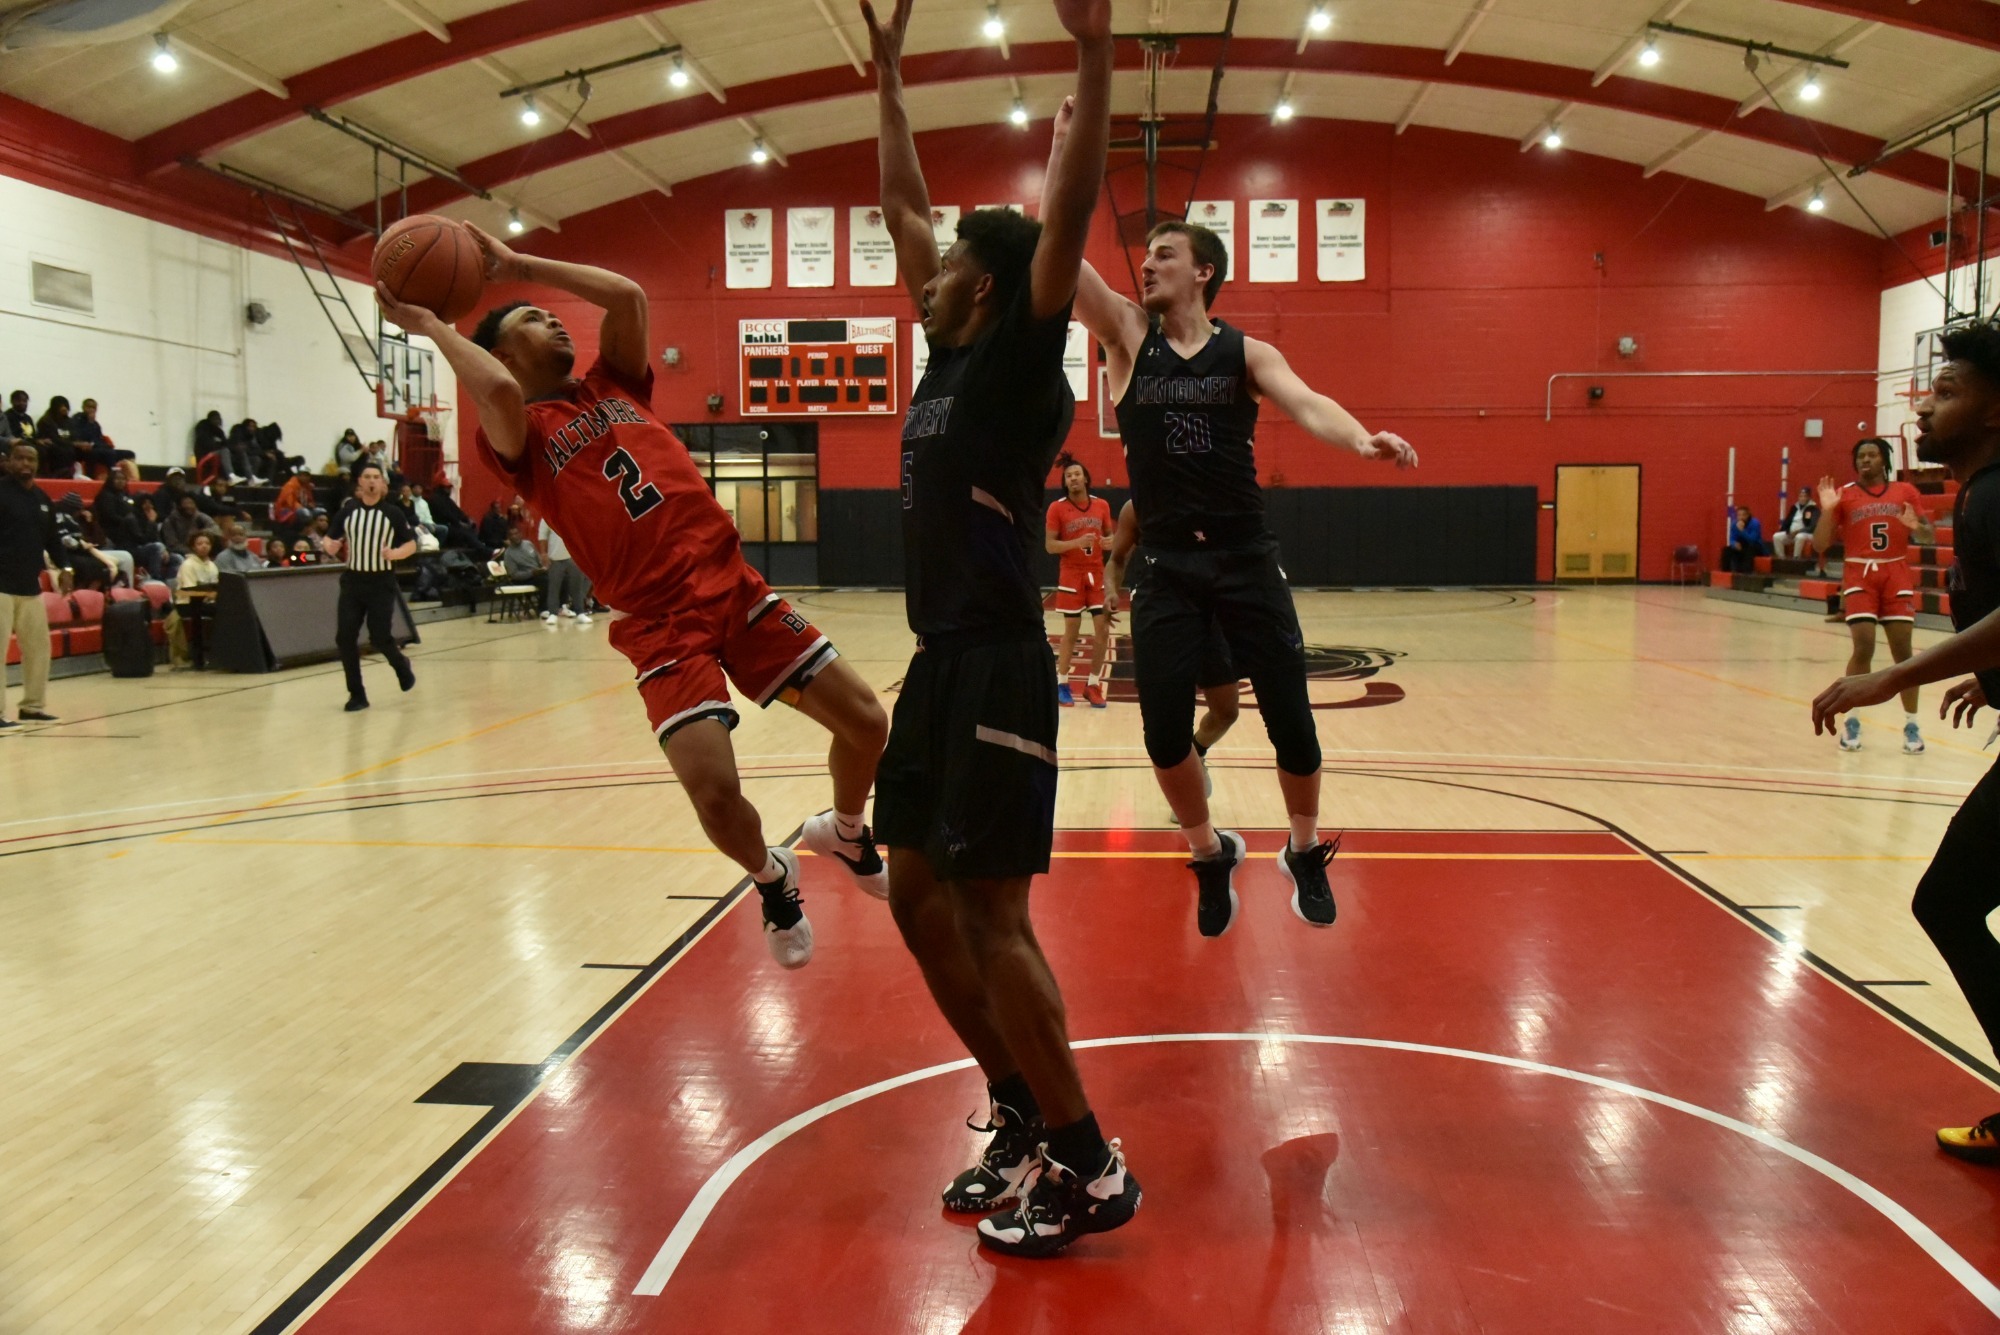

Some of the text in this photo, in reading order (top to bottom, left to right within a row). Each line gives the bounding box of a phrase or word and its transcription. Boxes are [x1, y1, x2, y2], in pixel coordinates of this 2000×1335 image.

[745, 321, 782, 333] BCCC
[851, 324, 892, 340] BALTIMORE
[744, 345, 790, 357] PANTHERS
[856, 344, 884, 355] GUEST
[807, 352, 828, 360] PERIOD
[749, 380, 768, 388] FOULS
[775, 379, 791, 387] T.O.L.
[797, 379, 840, 387] PLAYER FOUL
[845, 378, 861, 387] T.O.L.
[868, 378, 887, 387] FOULS
[1136, 375, 1239, 405] MONTGOMERY
[749, 405, 768, 413] SCORE
[807, 405, 828, 413] MATCH
[868, 404, 887, 412] SCORE
[1164, 411, 1212, 454] 20
[602, 445, 664, 523] 2
[1870, 521, 1889, 552] 5
